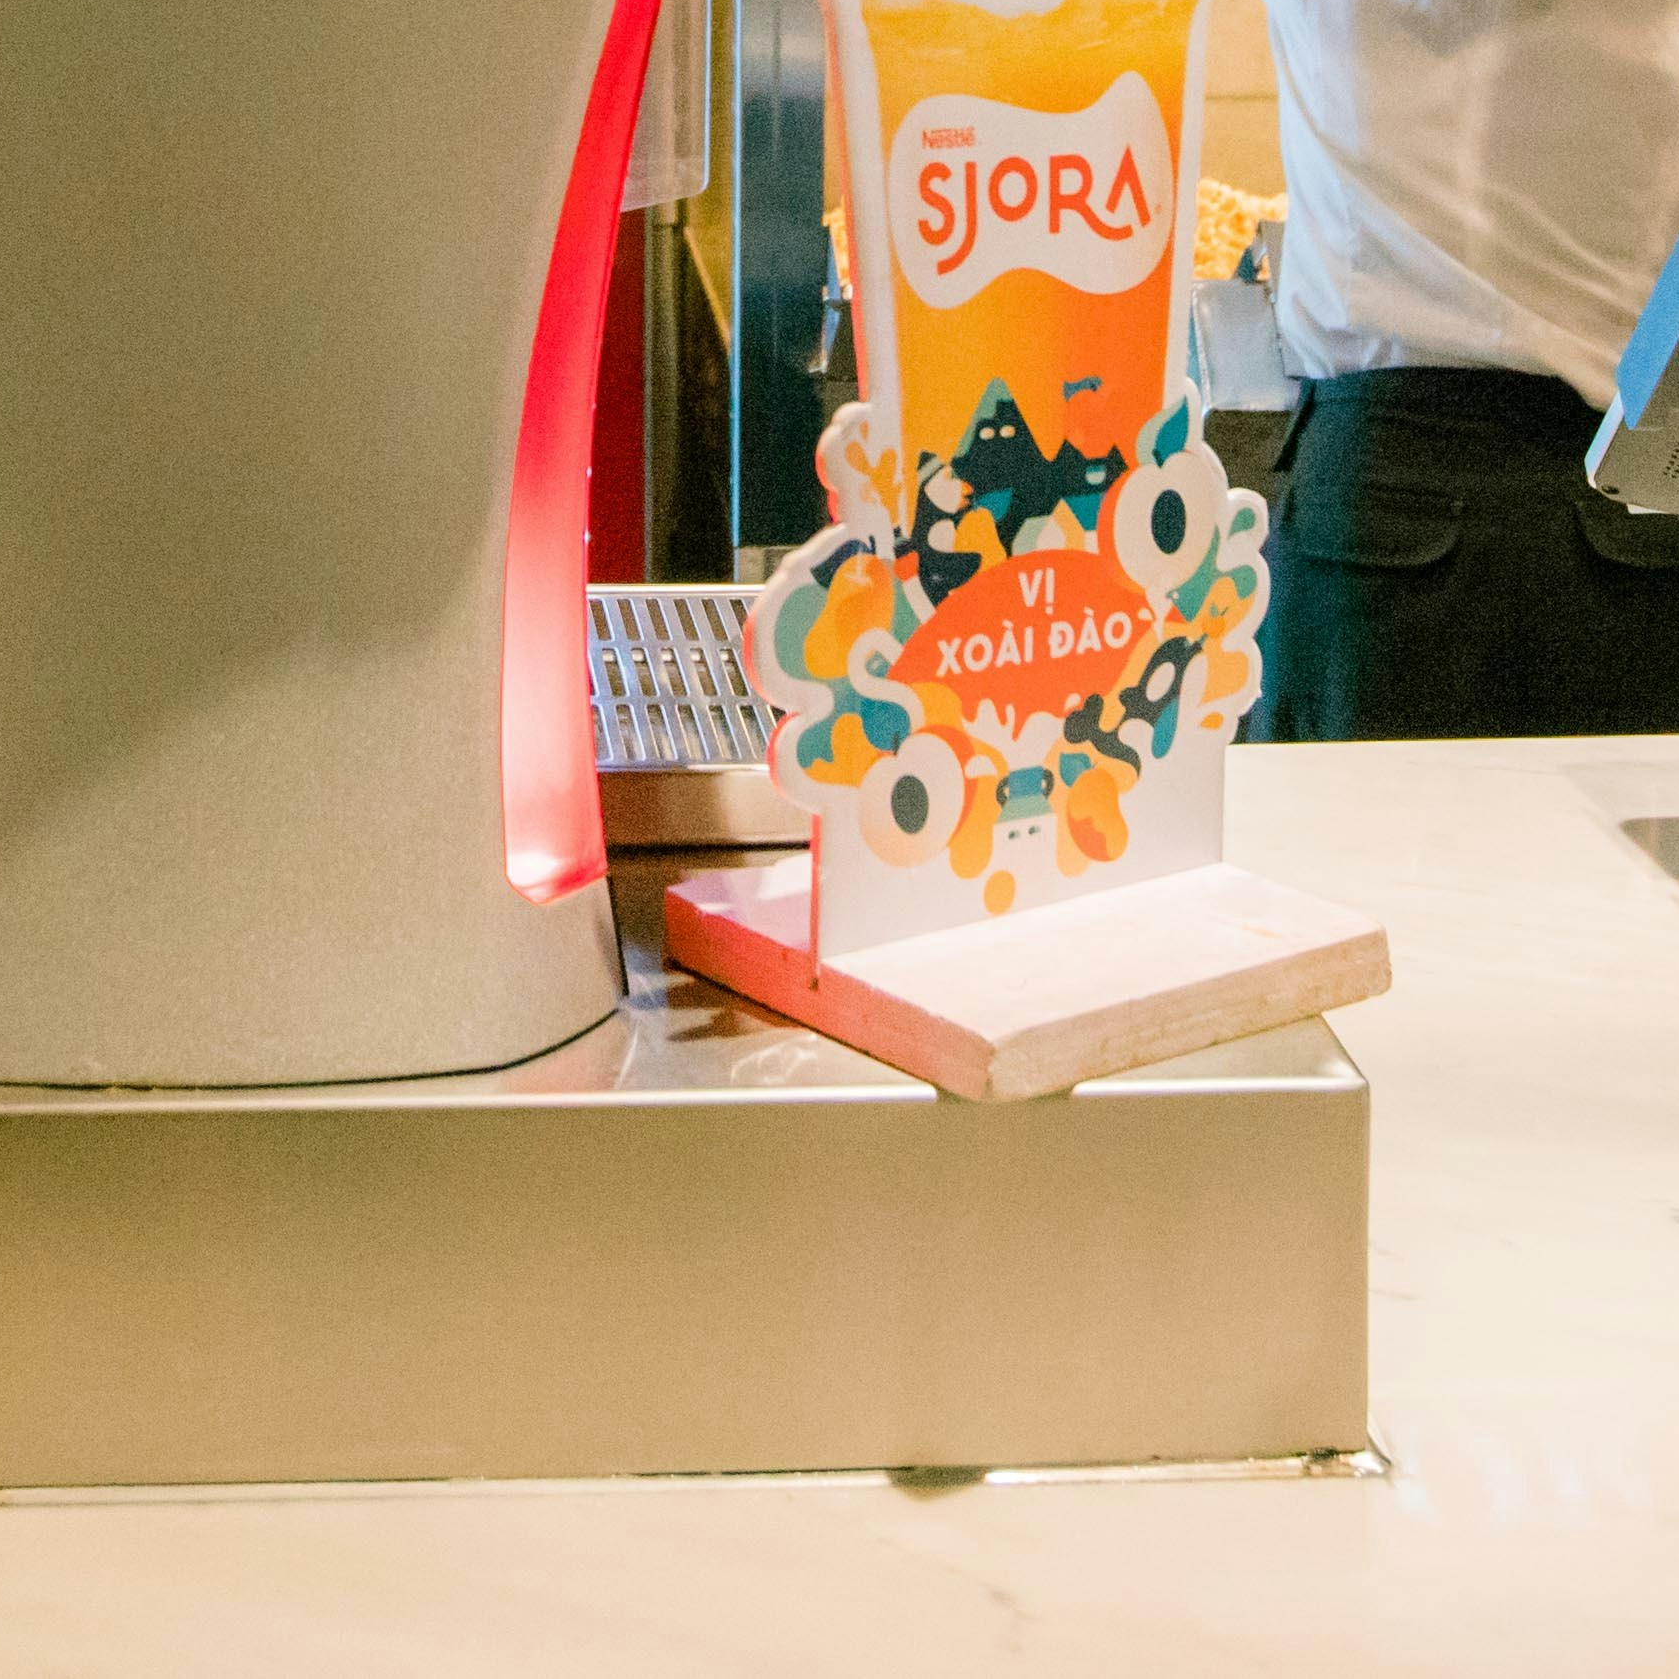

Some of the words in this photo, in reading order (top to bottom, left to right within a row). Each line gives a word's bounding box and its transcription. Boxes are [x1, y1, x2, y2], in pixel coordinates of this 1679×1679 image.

[918, 143, 1152, 275] SJORA
[1018, 567, 1055, 616] VỊ
[935, 619, 1035, 678] XOÀI
[1048, 606, 1133, 660] ĐÀO
